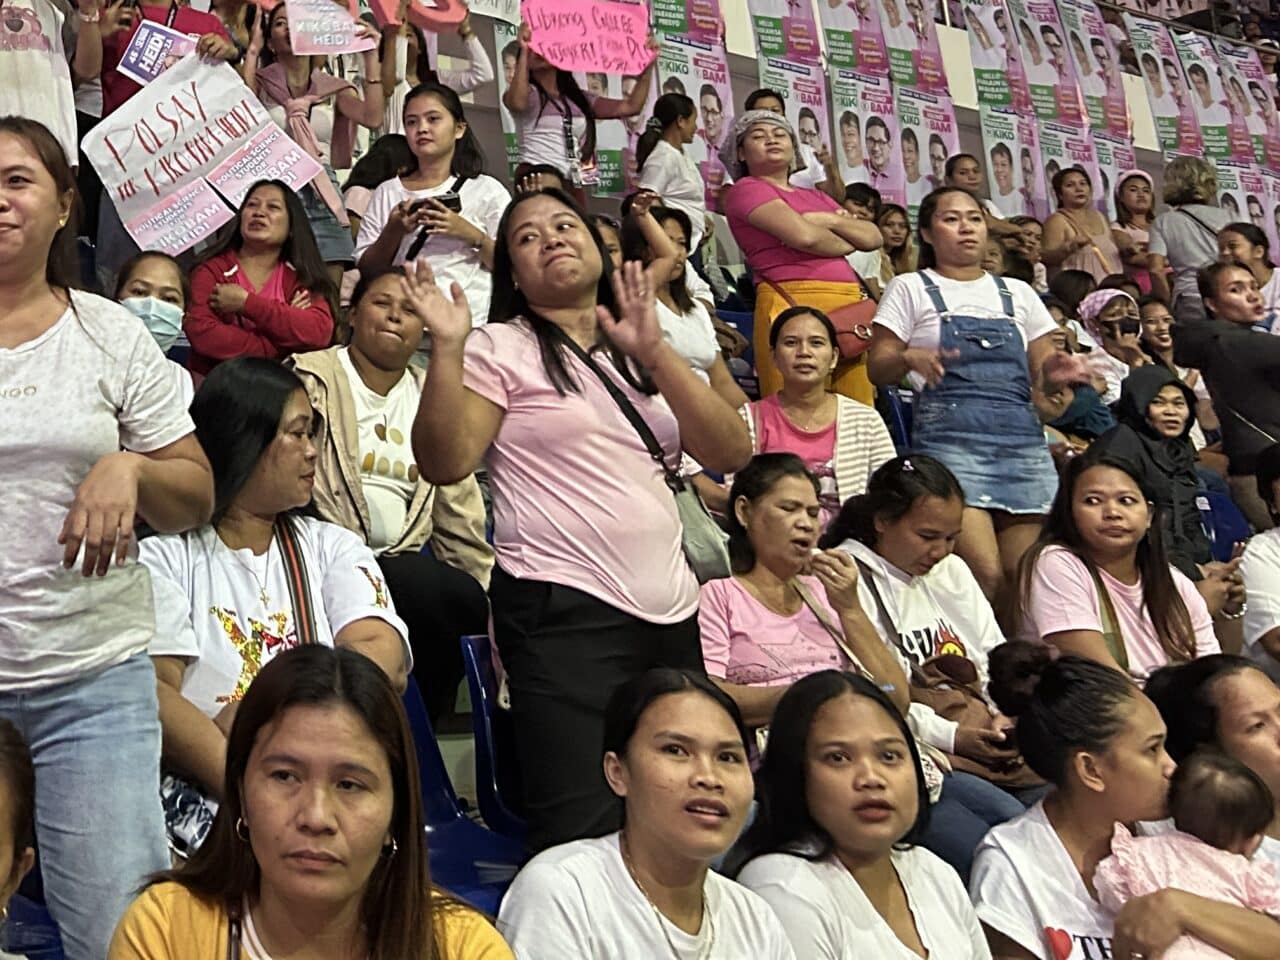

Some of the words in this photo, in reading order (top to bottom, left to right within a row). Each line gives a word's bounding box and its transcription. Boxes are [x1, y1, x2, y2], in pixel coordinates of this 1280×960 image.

[139, 32, 166, 72] HEIDI
[665, 61, 689, 75] KIKO
[702, 69, 727, 84] BAM
[801, 92, 823, 106] BAM
[870, 101, 894, 115] BAM
[930, 119, 952, 133] BAM
[993, 129, 1015, 140] KIKO
[216, 155, 253, 186] POLITICAL
